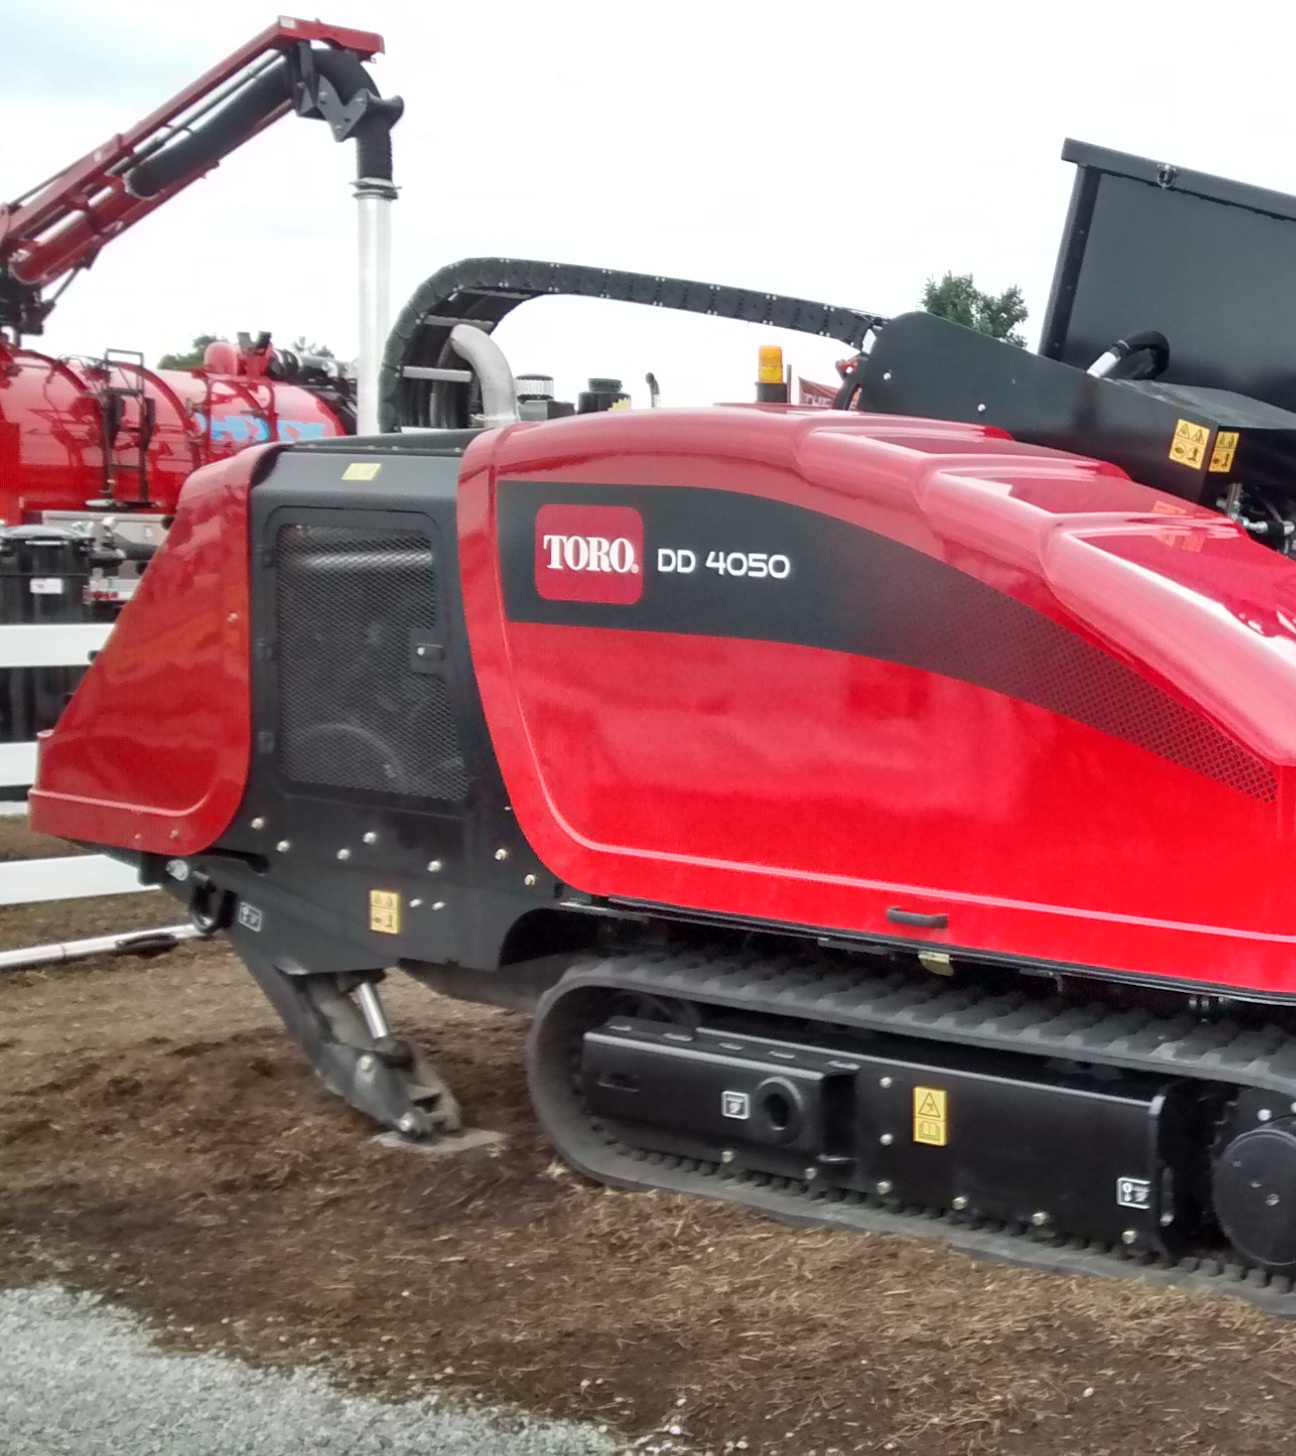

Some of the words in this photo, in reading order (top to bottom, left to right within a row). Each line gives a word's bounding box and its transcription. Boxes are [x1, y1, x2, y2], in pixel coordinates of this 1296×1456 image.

[543, 534, 639, 574] TORO
[657, 549, 696, 574] DD
[705, 551, 791, 579] 4050
